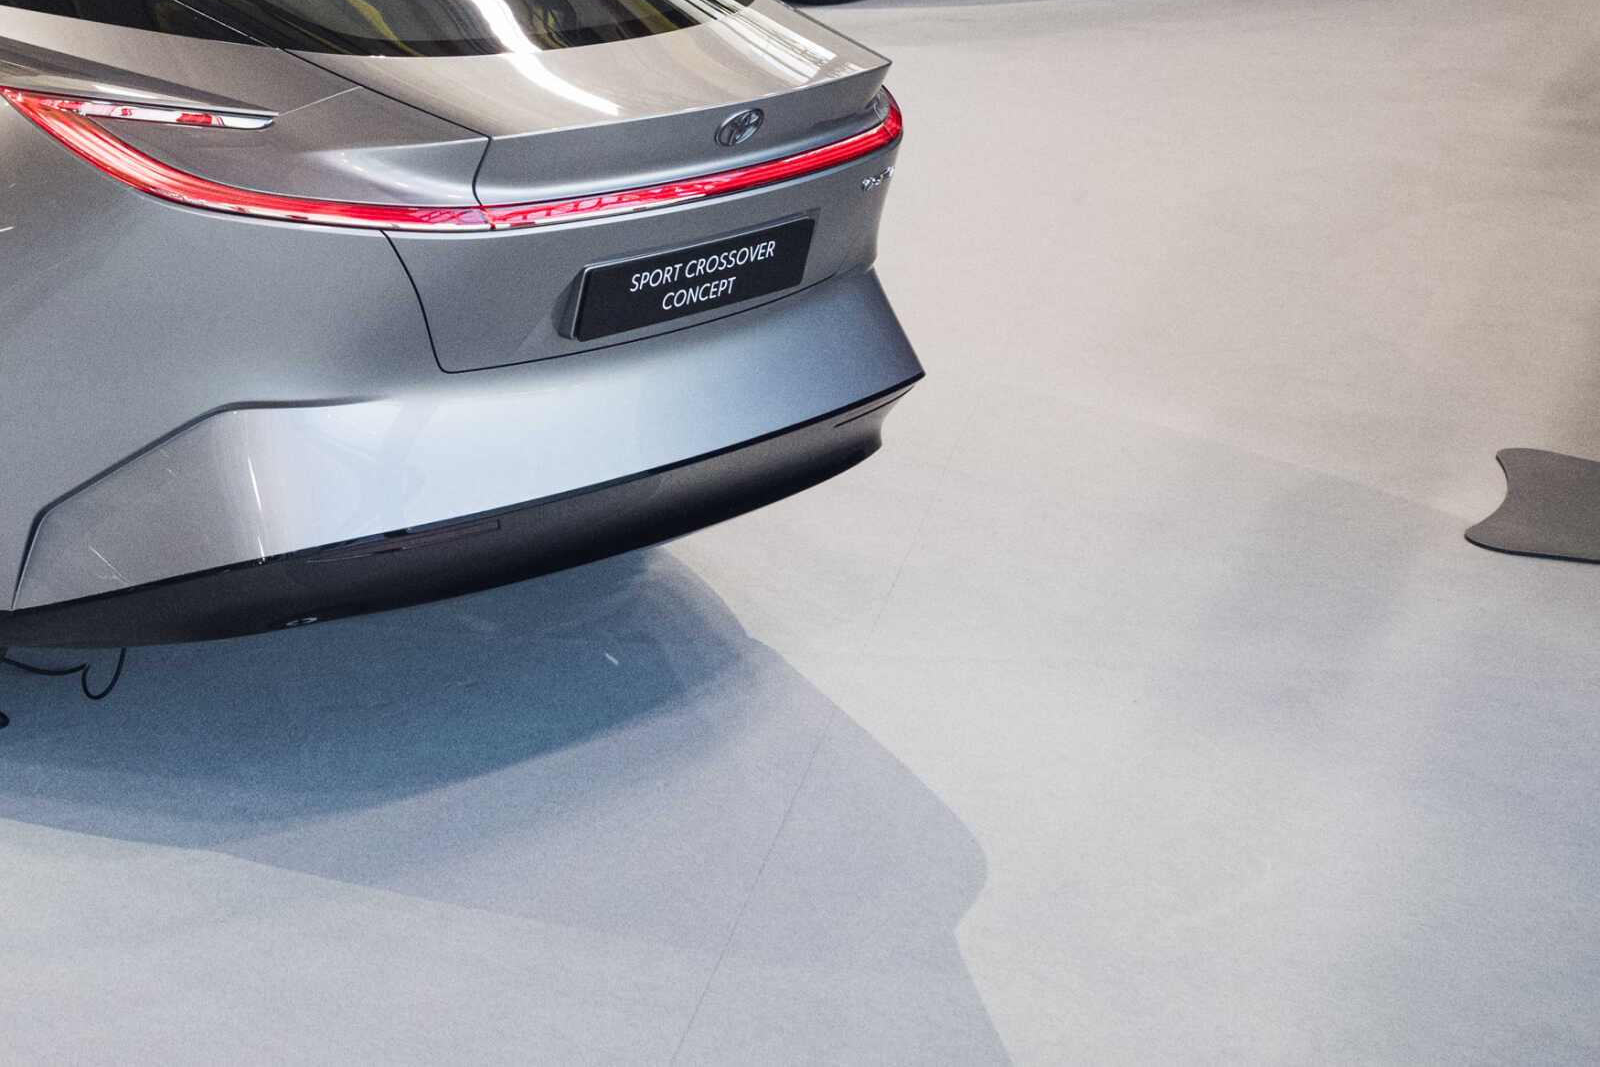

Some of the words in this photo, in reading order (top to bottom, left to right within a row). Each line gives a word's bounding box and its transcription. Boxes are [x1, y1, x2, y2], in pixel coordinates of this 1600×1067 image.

[629, 264, 682, 293] SPORT
[684, 240, 777, 278] CROSSOVER
[661, 276, 738, 310] CONCEPT
